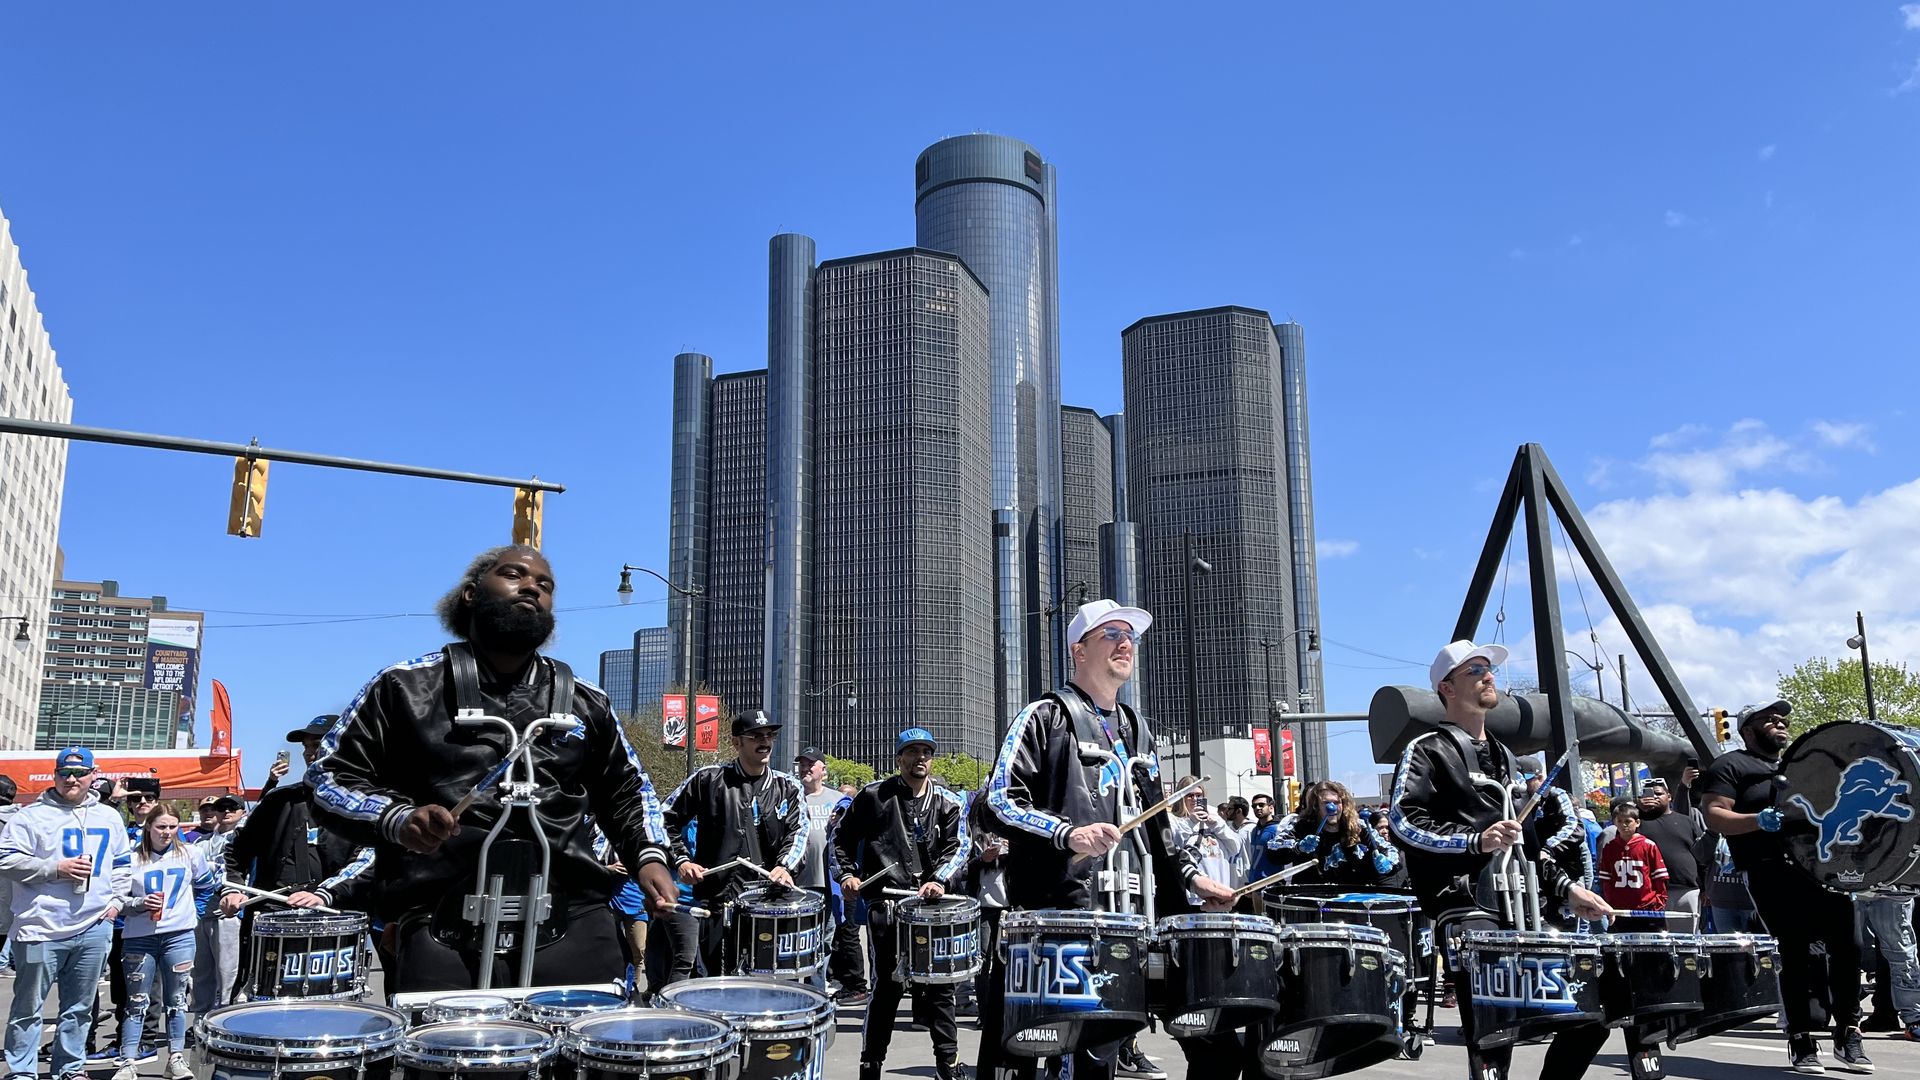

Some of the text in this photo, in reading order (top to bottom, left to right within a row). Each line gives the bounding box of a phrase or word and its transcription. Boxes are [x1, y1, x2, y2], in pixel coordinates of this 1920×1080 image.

[161, 656, 189, 664] MARRIOTT
[1022, 813, 1050, 829] LIONS
[62, 827, 110, 877] 97
[1614, 860, 1644, 889] 95
[144, 867, 186, 909] 97
[499, 933, 514, 948] M
[284, 946, 355, 984] LIONS
[1024, 1029, 1058, 1041] YAMAHA
